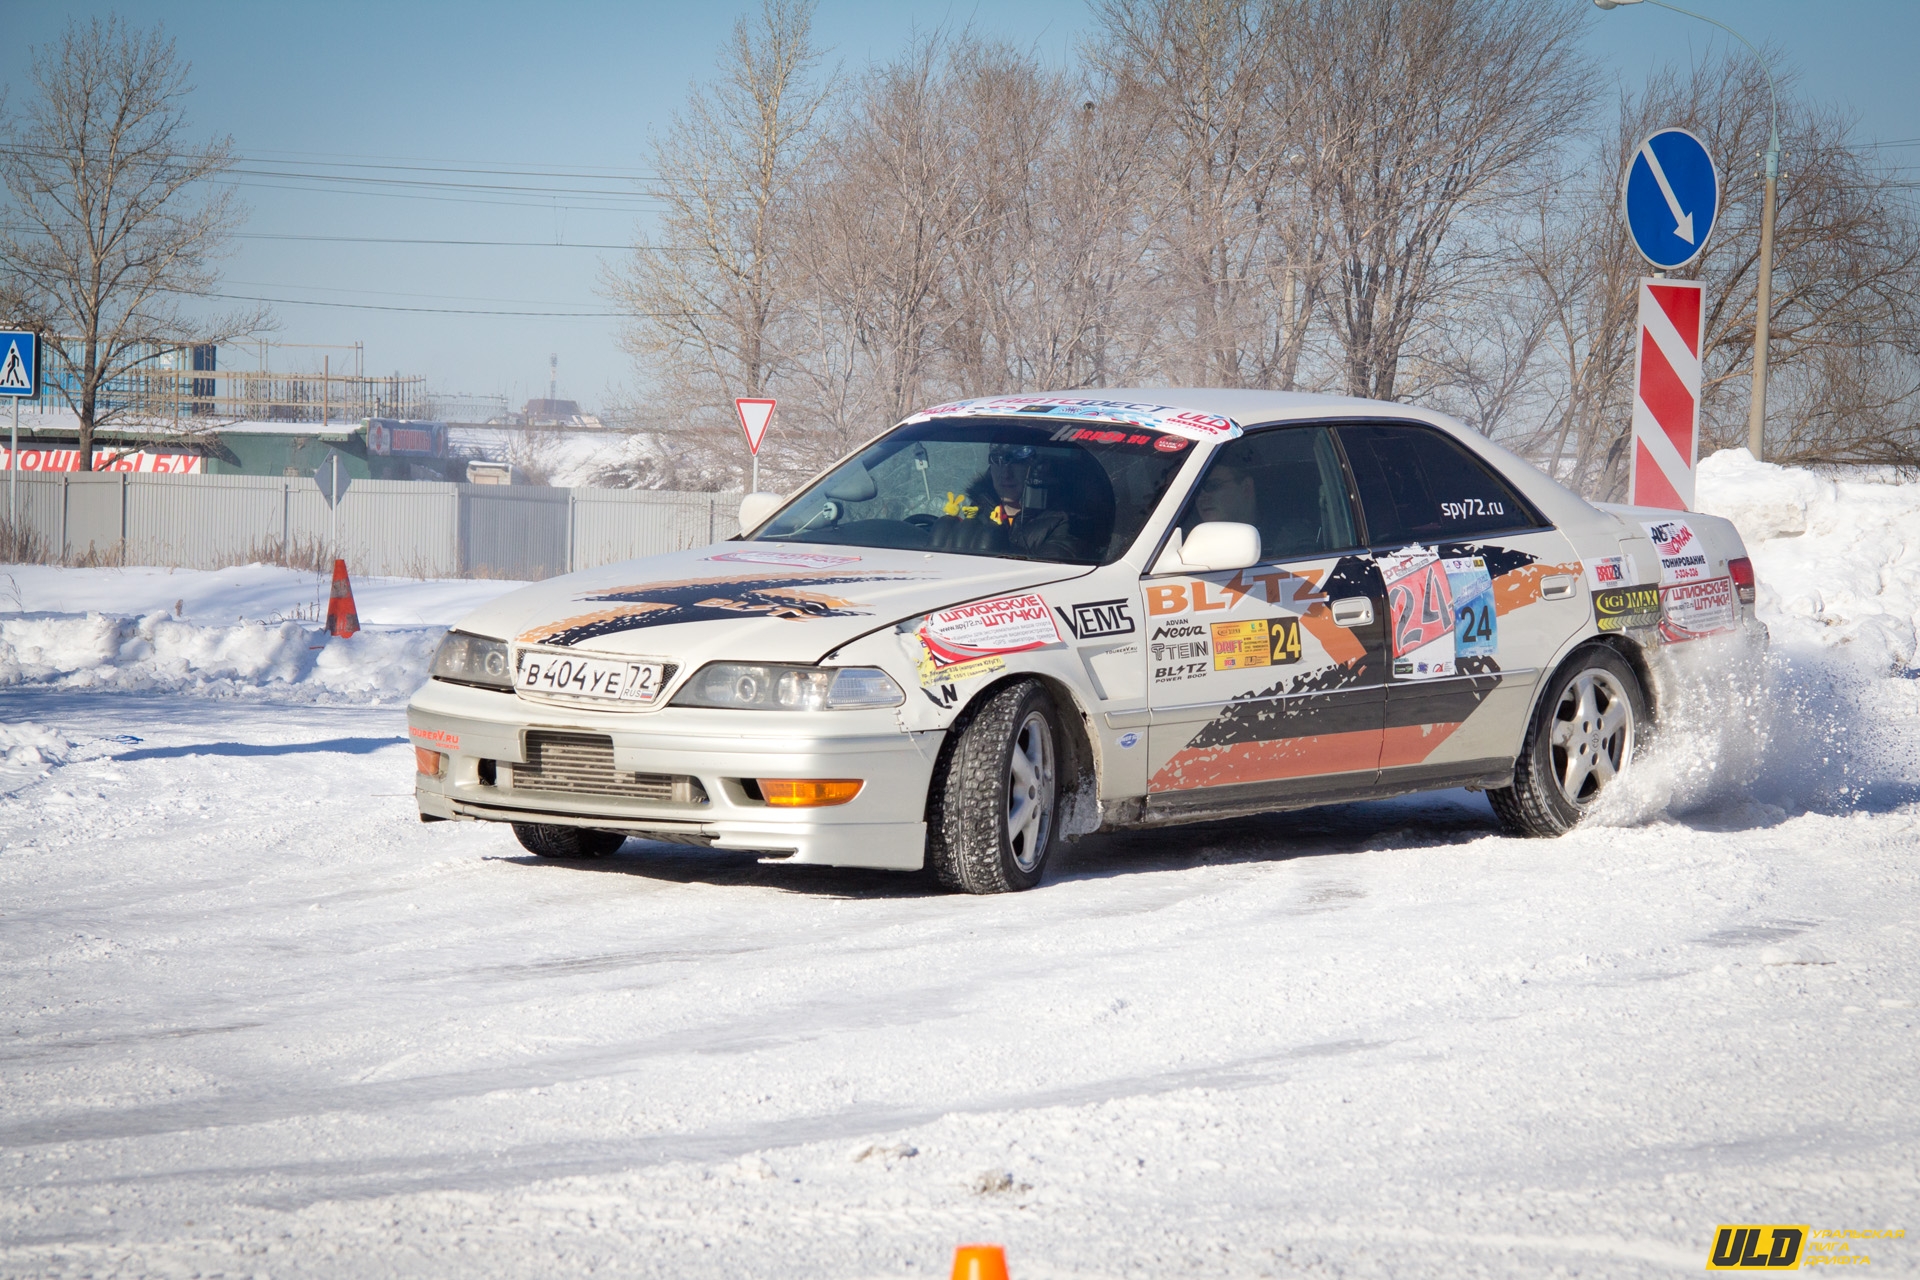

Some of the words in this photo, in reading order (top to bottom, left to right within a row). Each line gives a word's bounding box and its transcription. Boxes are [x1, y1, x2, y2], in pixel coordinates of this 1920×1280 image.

[1177, 412, 1230, 430] ULD
[152, 453, 199, 473] Б/У
[1441, 499, 1504, 519] spy72.ru
[1662, 555, 1706, 568] ТОНИРОВАНИЕ
[1672, 580, 1728, 600] ШПИОНСКИЕ
[939, 596, 1039, 622] ШПИОНСКИЕ
[1389, 565, 1454, 652] 24
[1694, 593, 1729, 610] ШТУЧКИ
[940, 619, 983, 633] www.spy72.ru
[981, 607, 1047, 627] ШТУЧКИ
[1054, 598, 1136, 639] VEMS
[1461, 605, 1492, 643] 24
[1151, 625, 1207, 641] Neova
[1271, 622, 1301, 660] 24
[1215, 639, 1243, 654] DRIFT
[526, 659, 621, 694] В404УЕ
[630, 665, 652, 689] 72
[623, 689, 641, 697] RUS
